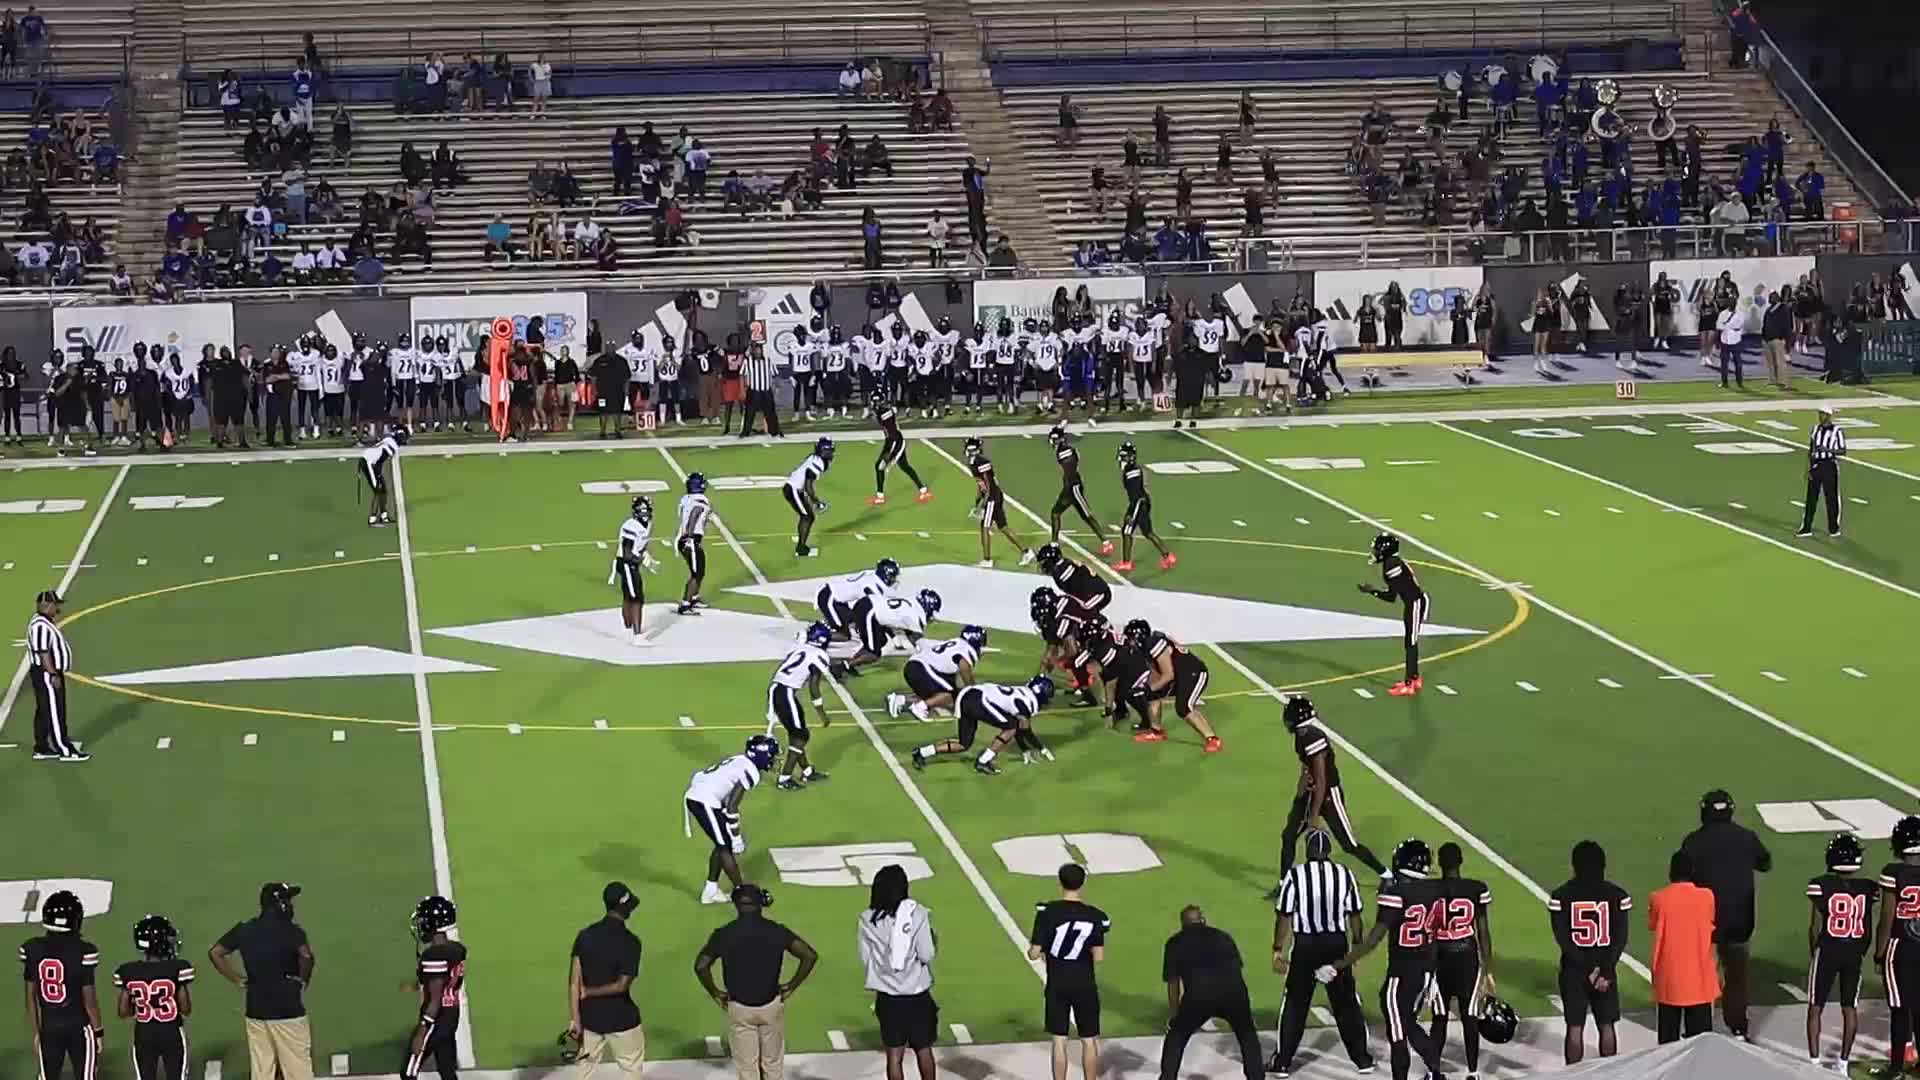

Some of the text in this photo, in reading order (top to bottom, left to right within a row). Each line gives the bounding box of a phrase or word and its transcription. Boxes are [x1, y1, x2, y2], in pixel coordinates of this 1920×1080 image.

[1040, 344, 1054, 360] 19
[113, 380, 127, 395] 19
[1156, 395, 1171, 410] 40
[1617, 382, 1633, 396] 30
[638, 412, 654, 428] 50
[769, 832, 1164, 887] 50
[1570, 900, 1611, 947] 51
[1827, 892, 1866, 938] 81
[1049, 920, 1094, 961] 17
[38, 958, 67, 1003] 8
[126, 979, 179, 1023] 33
